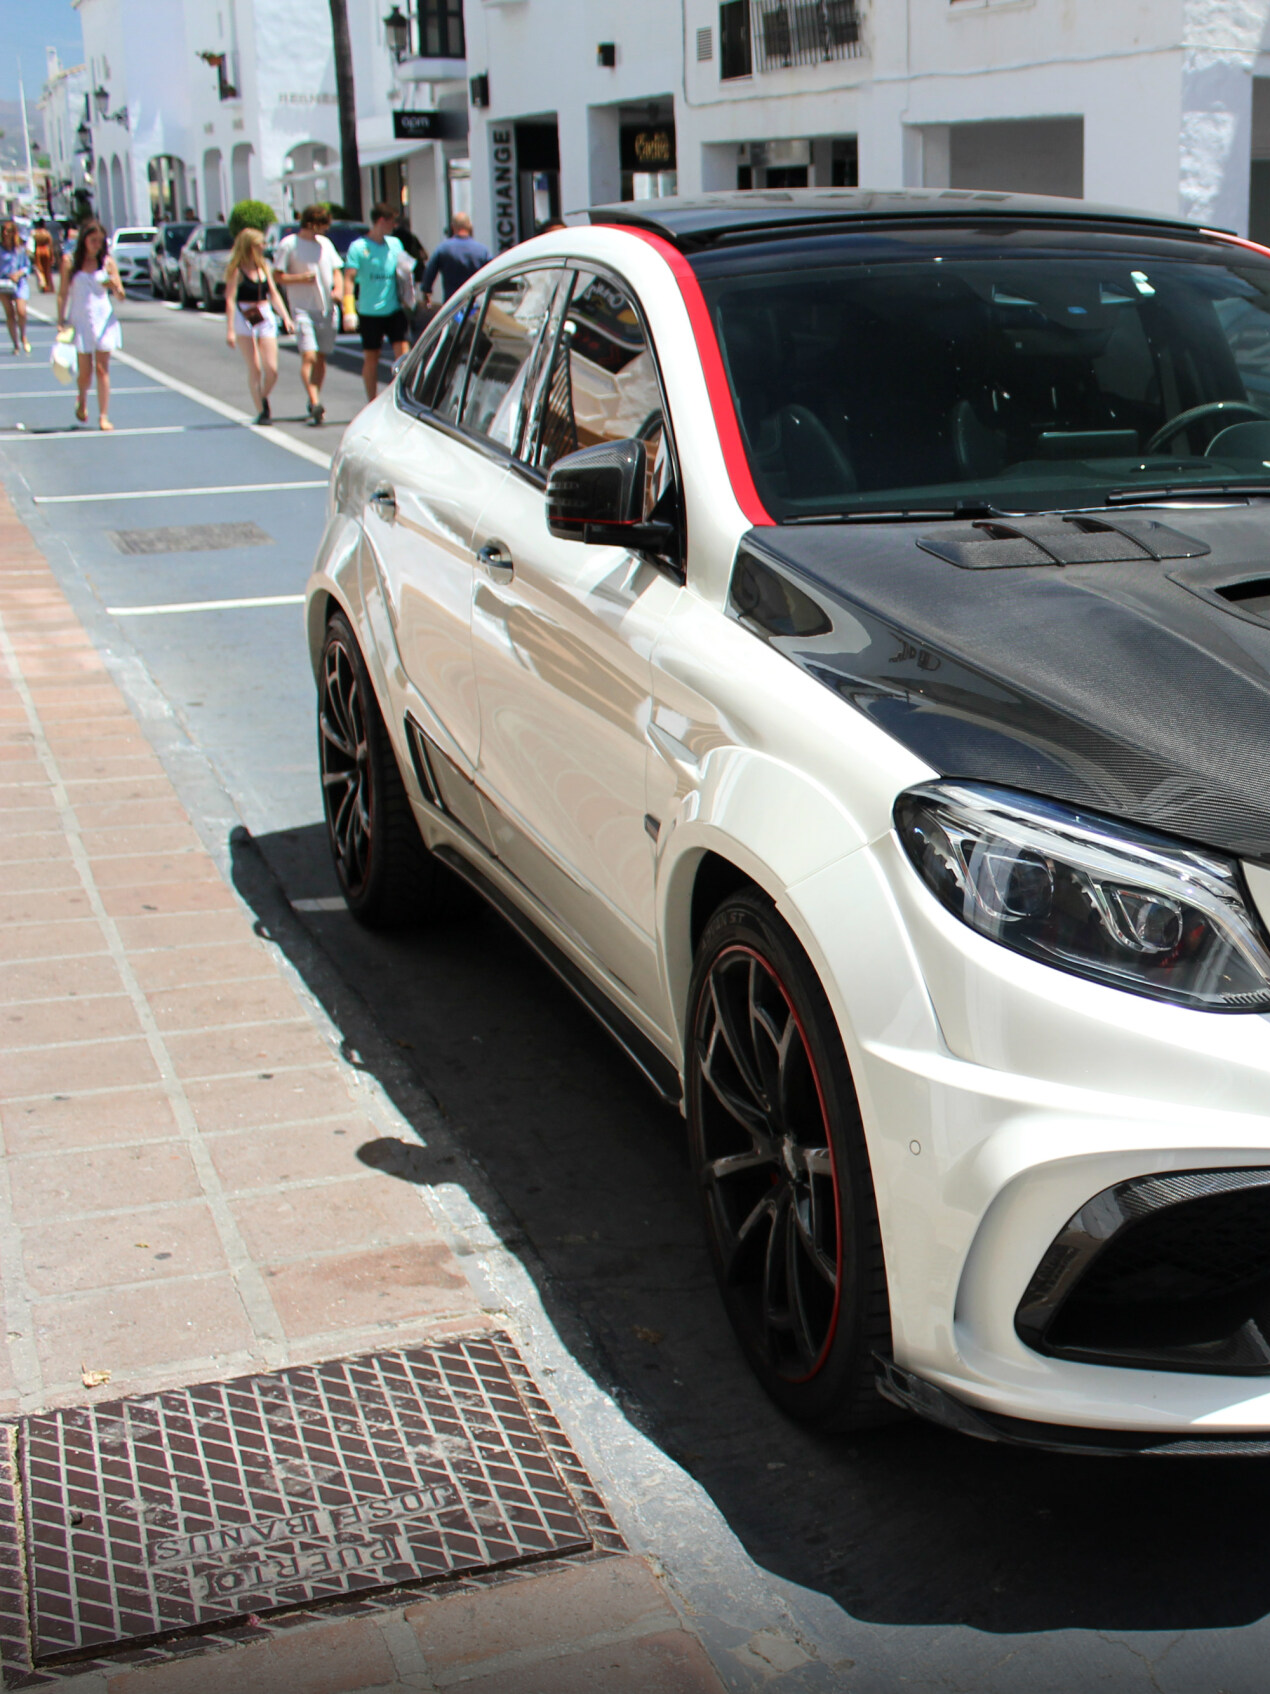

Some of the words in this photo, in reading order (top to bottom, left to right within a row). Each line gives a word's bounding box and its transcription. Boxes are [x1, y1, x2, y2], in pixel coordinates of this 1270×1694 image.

[493, 130, 515, 252] XCHANGE
[337, 1486, 452, 1530] JOSE
[155, 1516, 311, 1560] BANUS
[212, 1537, 397, 1595] PUERTO
